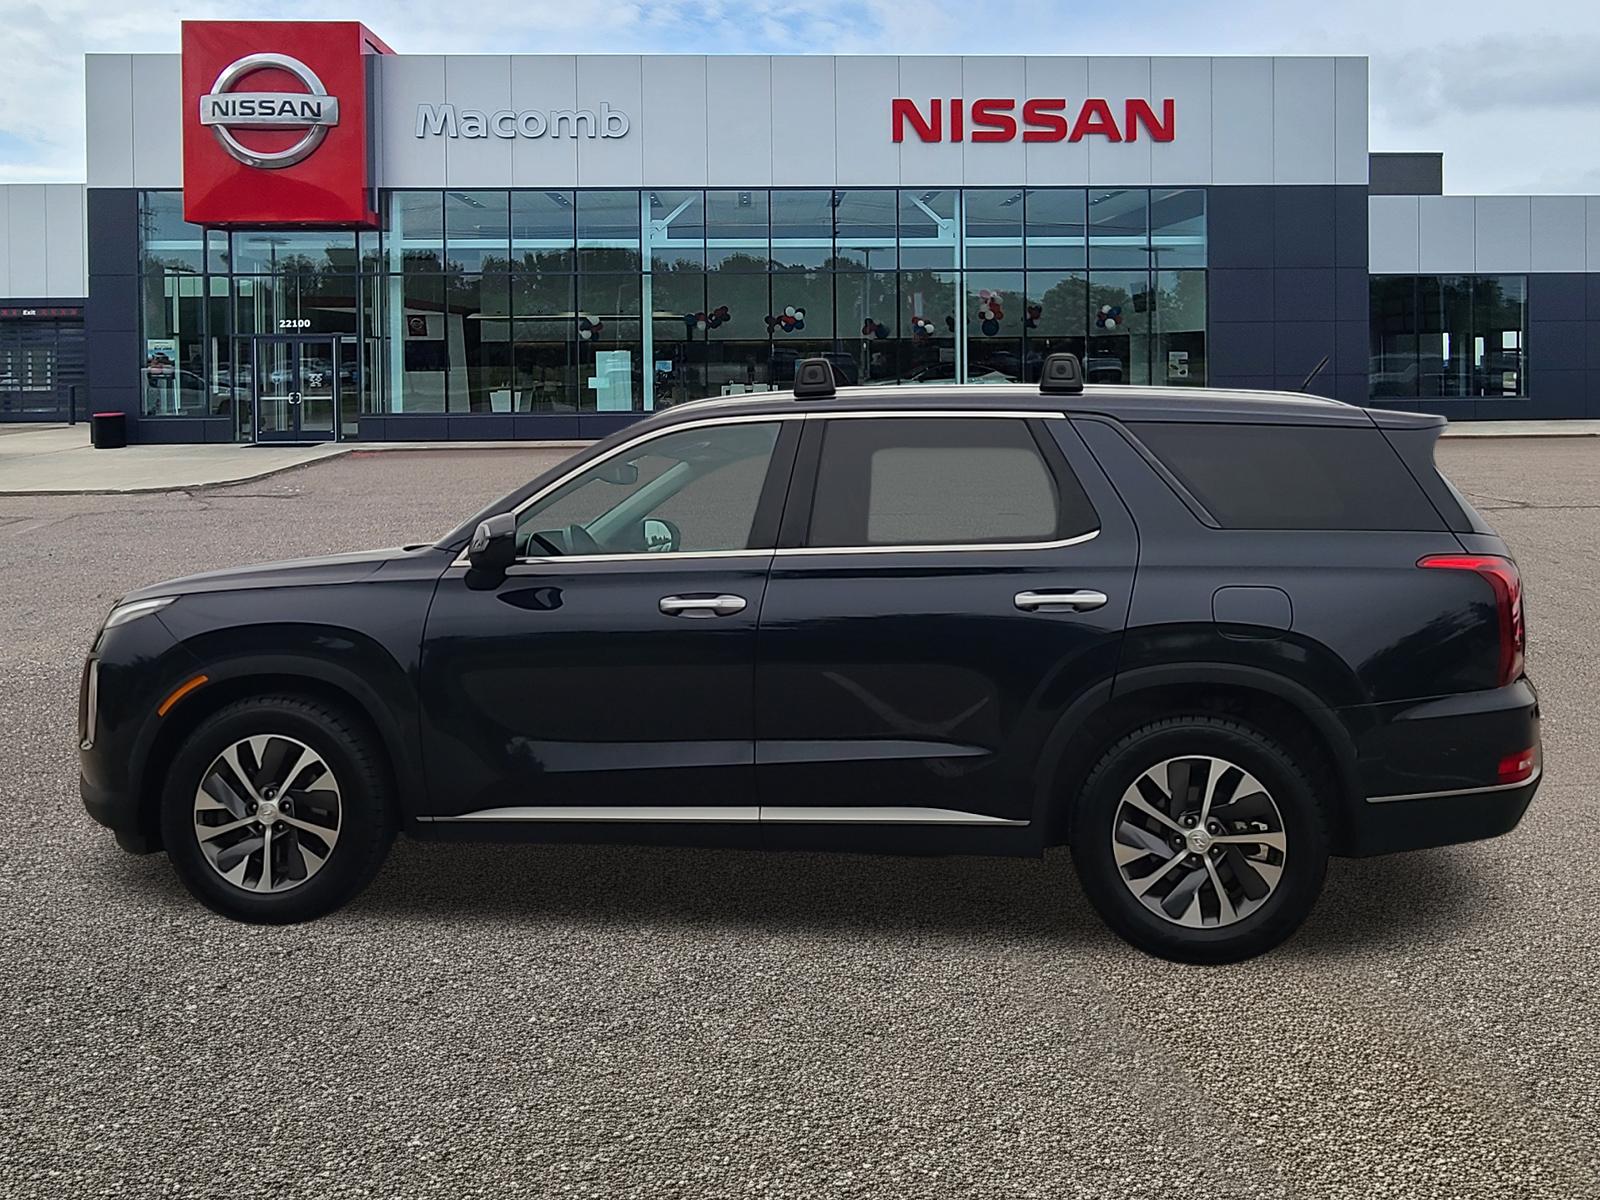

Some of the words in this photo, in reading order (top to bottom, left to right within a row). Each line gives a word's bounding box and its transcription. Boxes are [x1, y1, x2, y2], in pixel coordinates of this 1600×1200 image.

[212, 100, 322, 117] NISSAN
[415, 101, 630, 139] Macomb
[892, 98, 1175, 142] NISSAN
[279, 319, 311, 328] 22100
